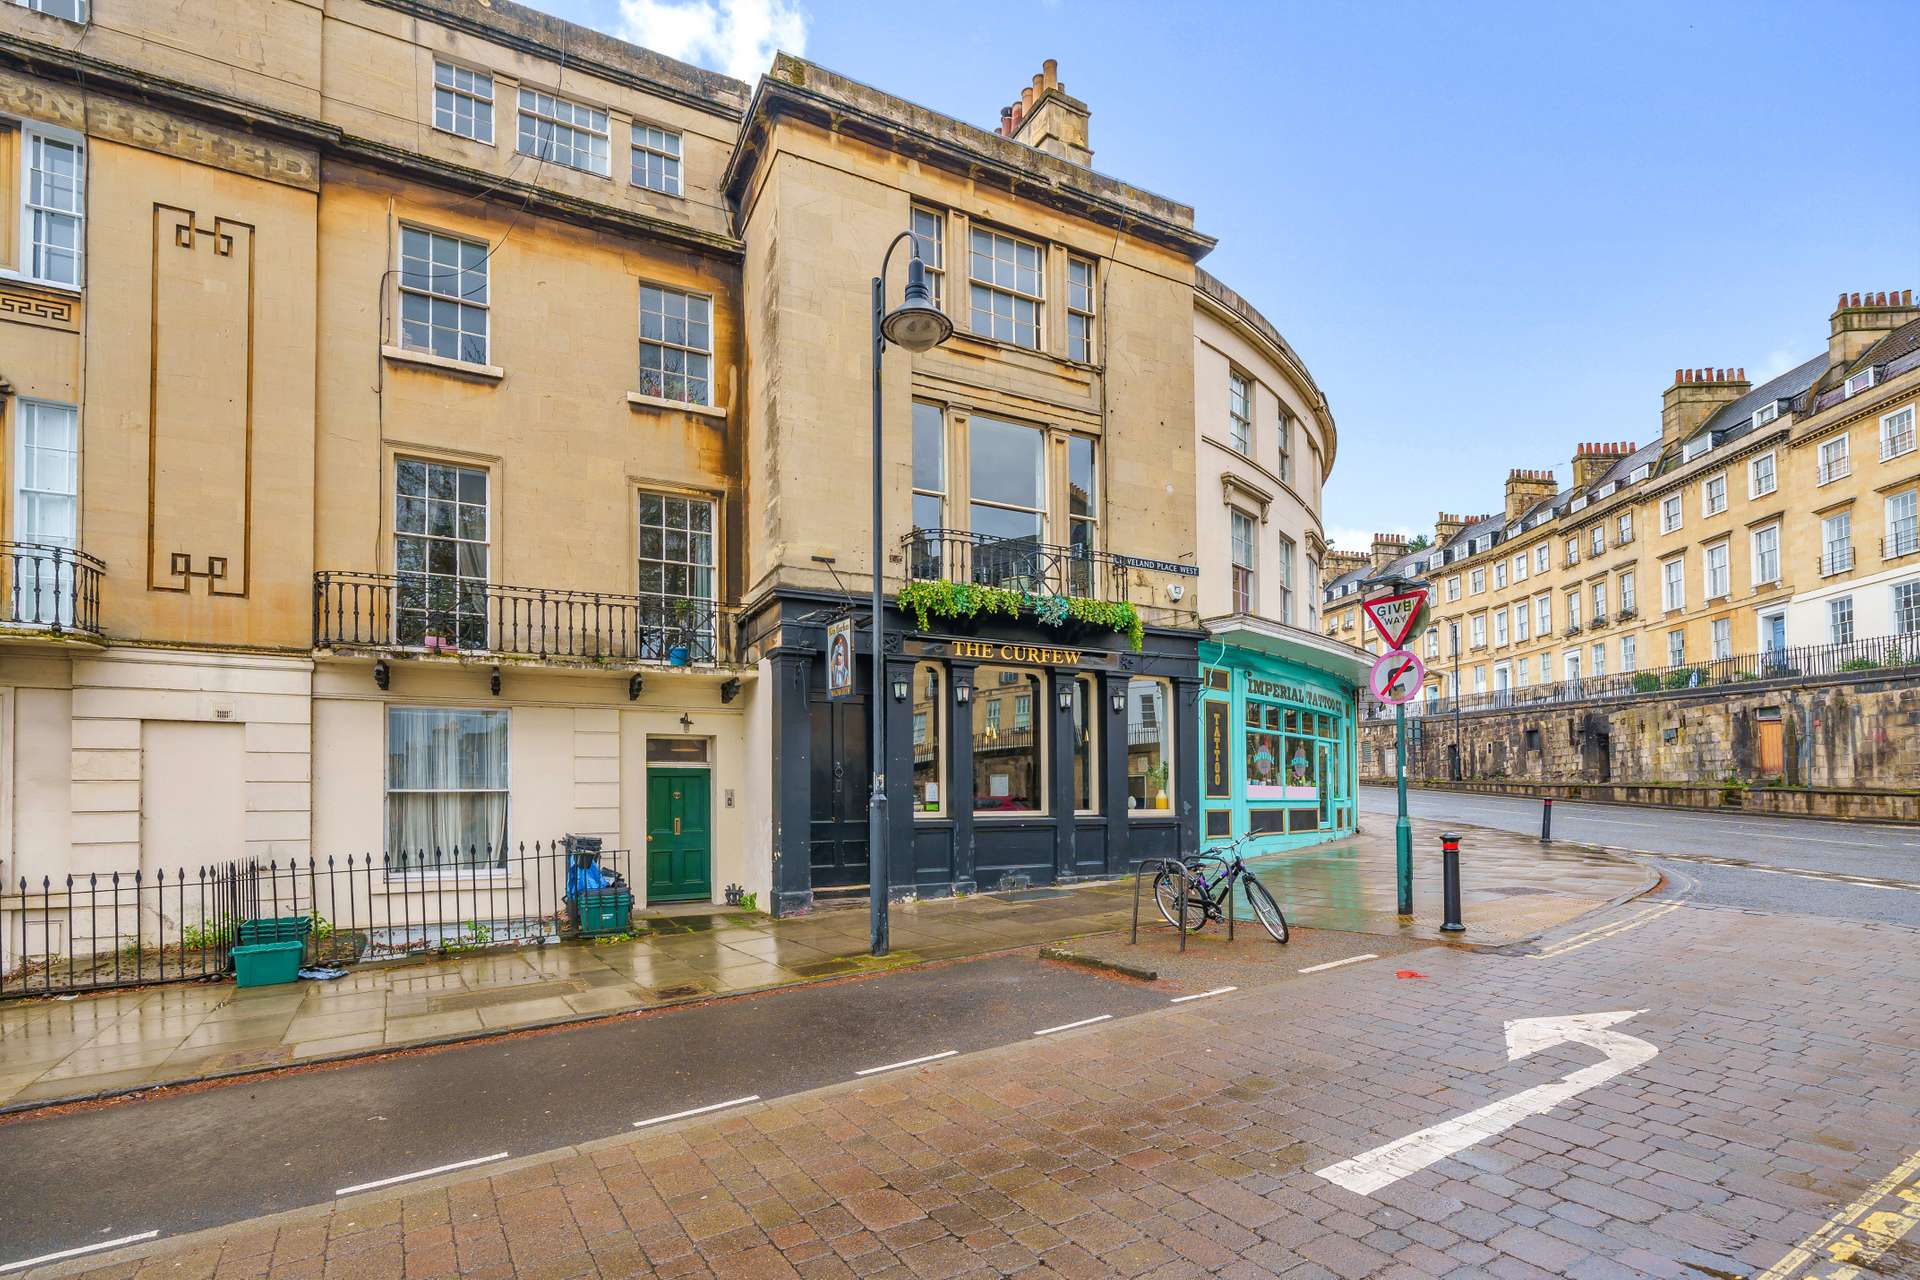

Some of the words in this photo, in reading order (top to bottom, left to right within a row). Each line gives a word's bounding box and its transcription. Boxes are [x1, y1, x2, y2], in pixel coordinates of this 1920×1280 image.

[1157, 562, 1178, 572] PLACE
[1180, 566, 1198, 575] WEST
[1376, 601, 1412, 617] GIVE
[1384, 614, 1407, 626] WAY
[952, 641, 994, 659] THE
[1000, 645, 1082, 665] CURFEW
[1247, 678, 1305, 704] IMPERIAL
[1306, 690, 1335, 711] TATTOO
[1213, 712, 1222, 787] TATTOO
